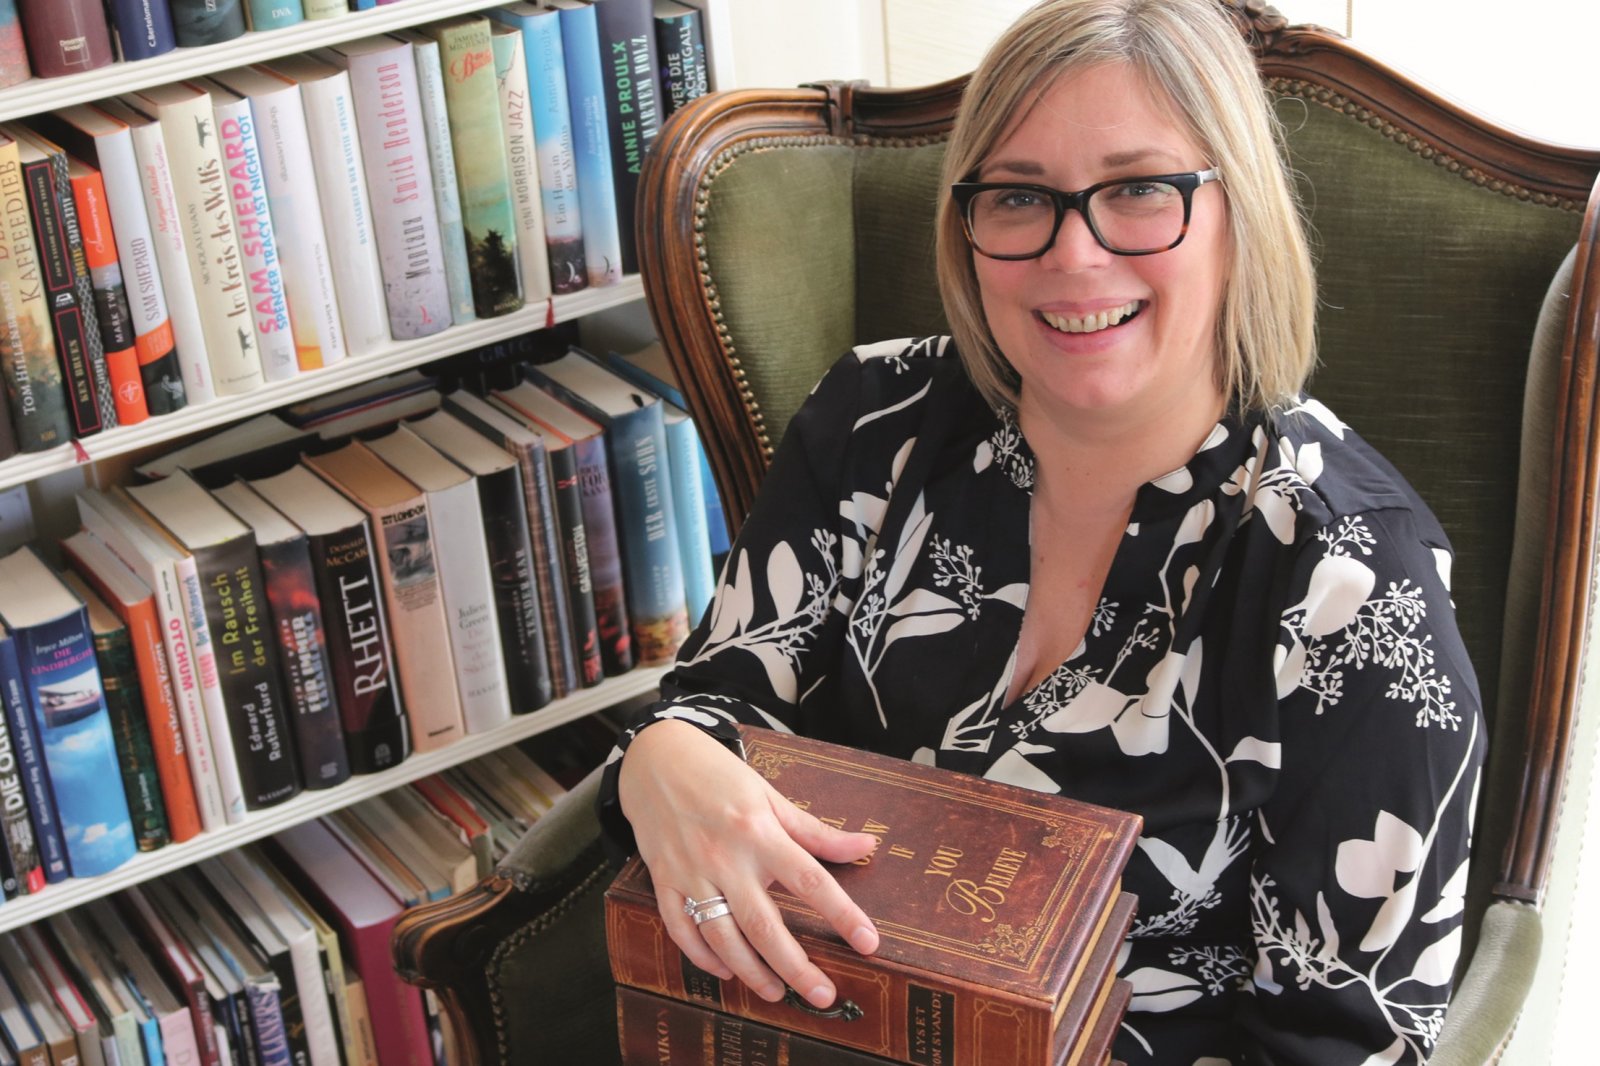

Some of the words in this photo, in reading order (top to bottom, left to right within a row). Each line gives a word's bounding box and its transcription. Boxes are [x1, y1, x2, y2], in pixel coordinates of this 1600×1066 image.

[271, 9, 293, 19] DVA
[630, 34, 651, 75] HOLZ
[667, 52, 682, 77] DIE
[679, 24, 698, 102] ACHTIGALL
[612, 40, 634, 114] PROULX
[238, 113, 253, 143] TOT
[376, 62, 411, 150] Henderson
[507, 89, 525, 131] JAZZ
[636, 78, 659, 139] HARTEM
[243, 146, 262, 190] NICHT
[509, 134, 529, 204] MORRISON
[550, 154, 561, 167] in
[621, 120, 641, 174] ANNIE
[197, 157, 227, 213] Wolfs
[221, 116, 264, 257] SHEPARD
[386, 155, 419, 204] Smith
[552, 170, 564, 200] Haus
[563, 173, 575, 192] der
[62, 197, 76, 218] ALEX
[210, 209, 234, 244] des
[253, 195, 268, 215] IST
[522, 206, 535, 231] TONI
[555, 202, 568, 225] Ein
[0, 160, 41, 303] KAFFEEDIEB
[67, 218, 81, 244] CAPUS
[258, 221, 277, 266] TRACY
[402, 216, 431, 280] Montana
[130, 237, 156, 294] SHEPARD
[216, 244, 243, 294] Kreis
[102, 271, 118, 309] TWAIN
[144, 294, 161, 322] SAM
[226, 292, 248, 319] Im
[249, 268, 279, 335] SAM
[269, 269, 289, 330] SPENCER
[0, 280, 30, 383] HILLENBRAND
[110, 311, 125, 343] MARK
[68, 339, 85, 377] BRUEN
[20, 384, 37, 416] TOM
[77, 379, 90, 403] KEN
[634, 434, 657, 477] SOHN
[644, 510, 666, 542] DER
[515, 548, 528, 578] BAR
[571, 523, 592, 594] GALVESTON
[211, 572, 240, 645] Rausch
[235, 565, 260, 635] Freiheit
[519, 581, 537, 638] TENDER
[53, 647, 72, 660] DIE
[169, 618, 193, 692] OTCHUM
[250, 640, 267, 666] der
[291, 615, 315, 676] IMMER
[339, 576, 388, 697] RHETT
[229, 651, 247, 675] Im
[242, 703, 265, 751] Edward
[255, 682, 283, 761] Rutherfurd
[888, 843, 915, 860] IF
[924, 844, 964, 878] YOU
[945, 846, 1028, 923] BELIEVE
[915, 1005, 927, 1055] LYSET
[931, 991, 943, 1046] SVANDT
